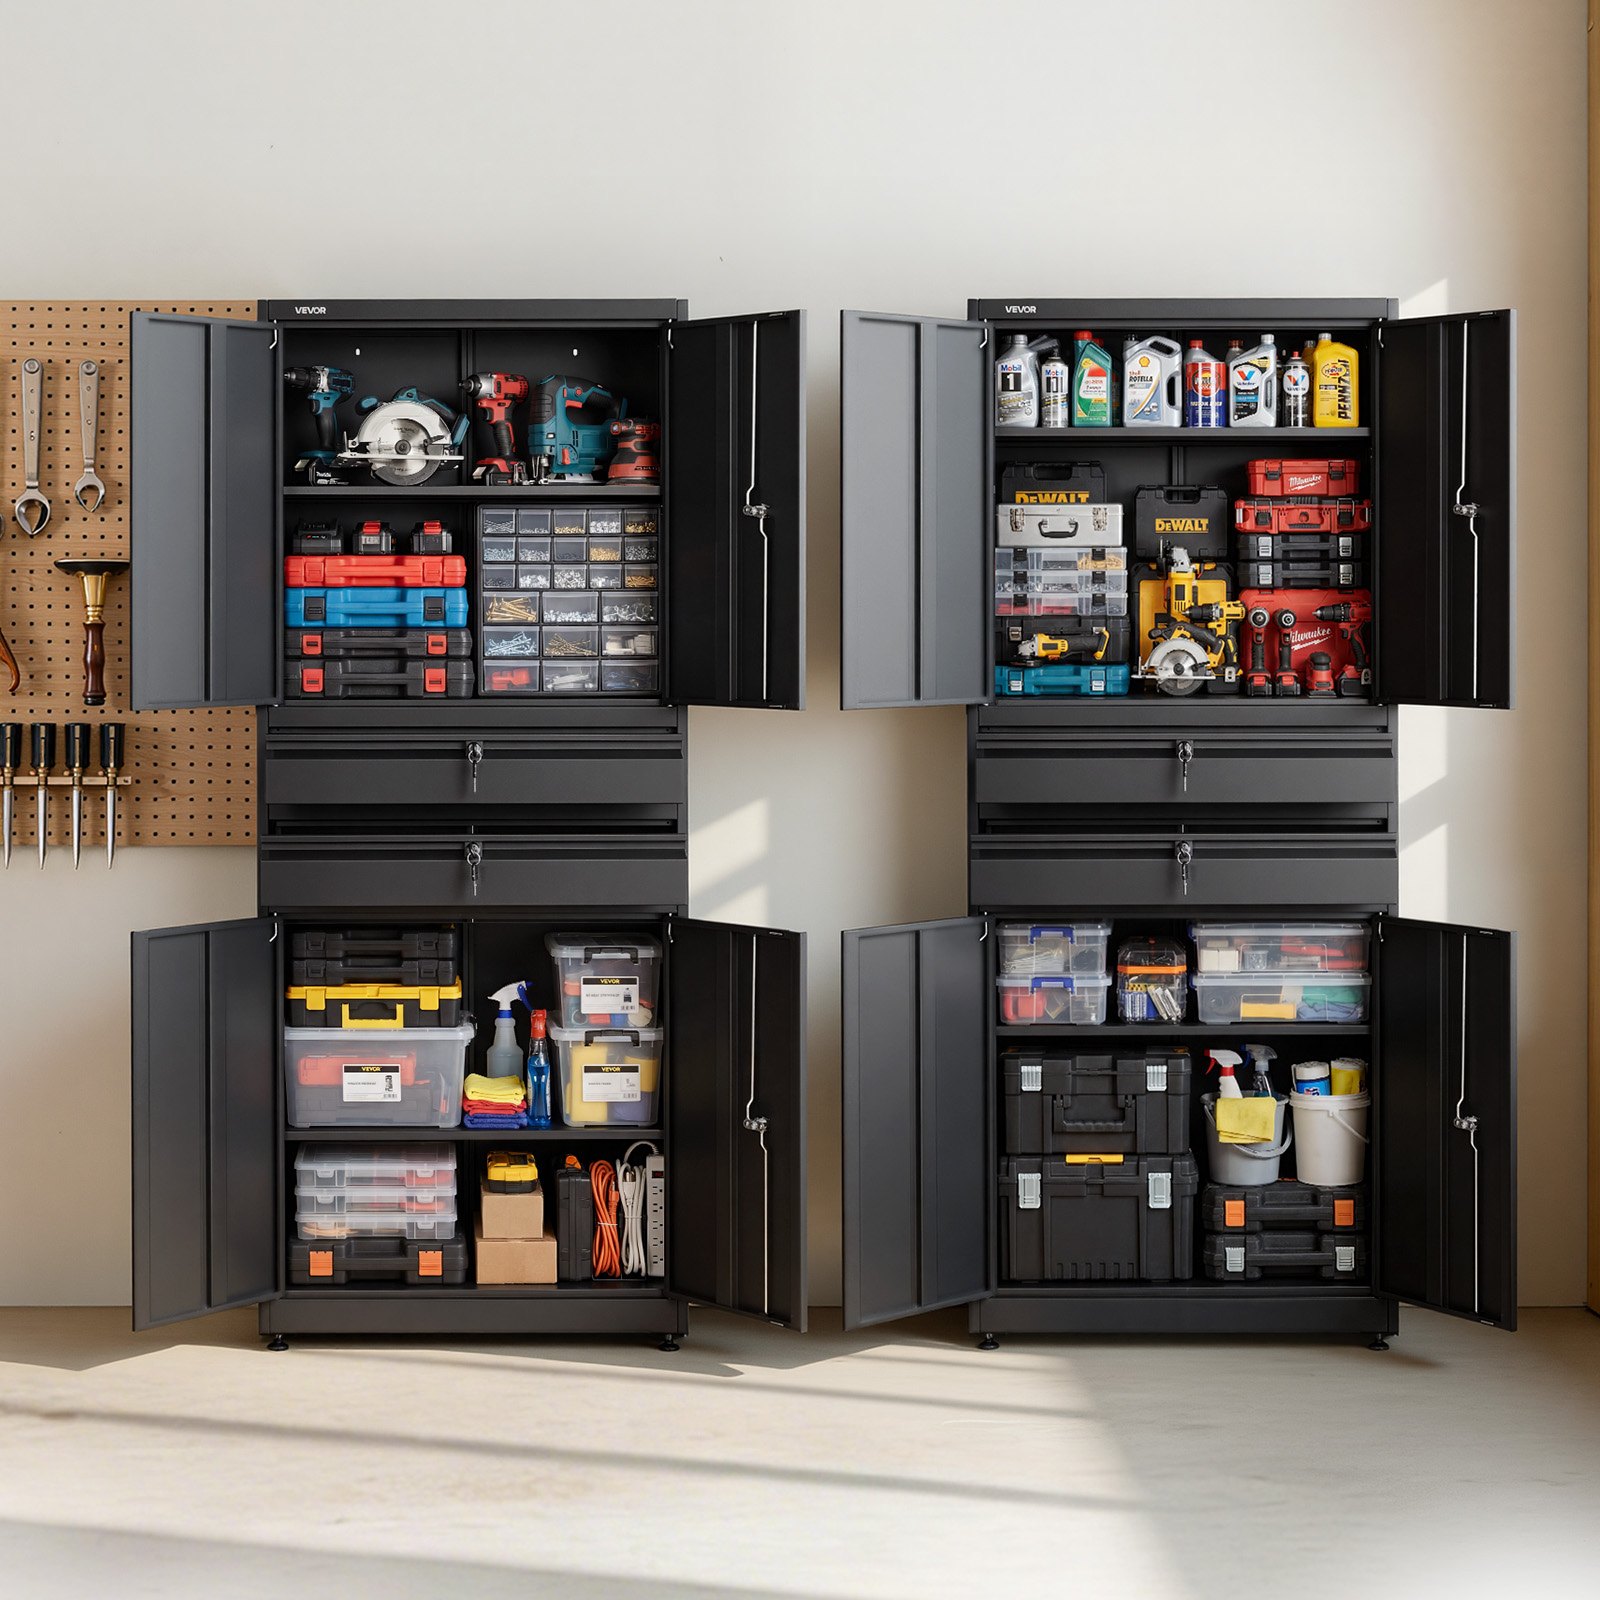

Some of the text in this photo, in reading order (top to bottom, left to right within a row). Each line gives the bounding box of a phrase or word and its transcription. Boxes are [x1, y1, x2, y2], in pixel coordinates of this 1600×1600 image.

[295, 306, 327, 315] VEVOR
[1005, 305, 1037, 314] VEVOR
[1001, 364, 1022, 372] Mobil
[1006, 373, 1015, 391] 1
